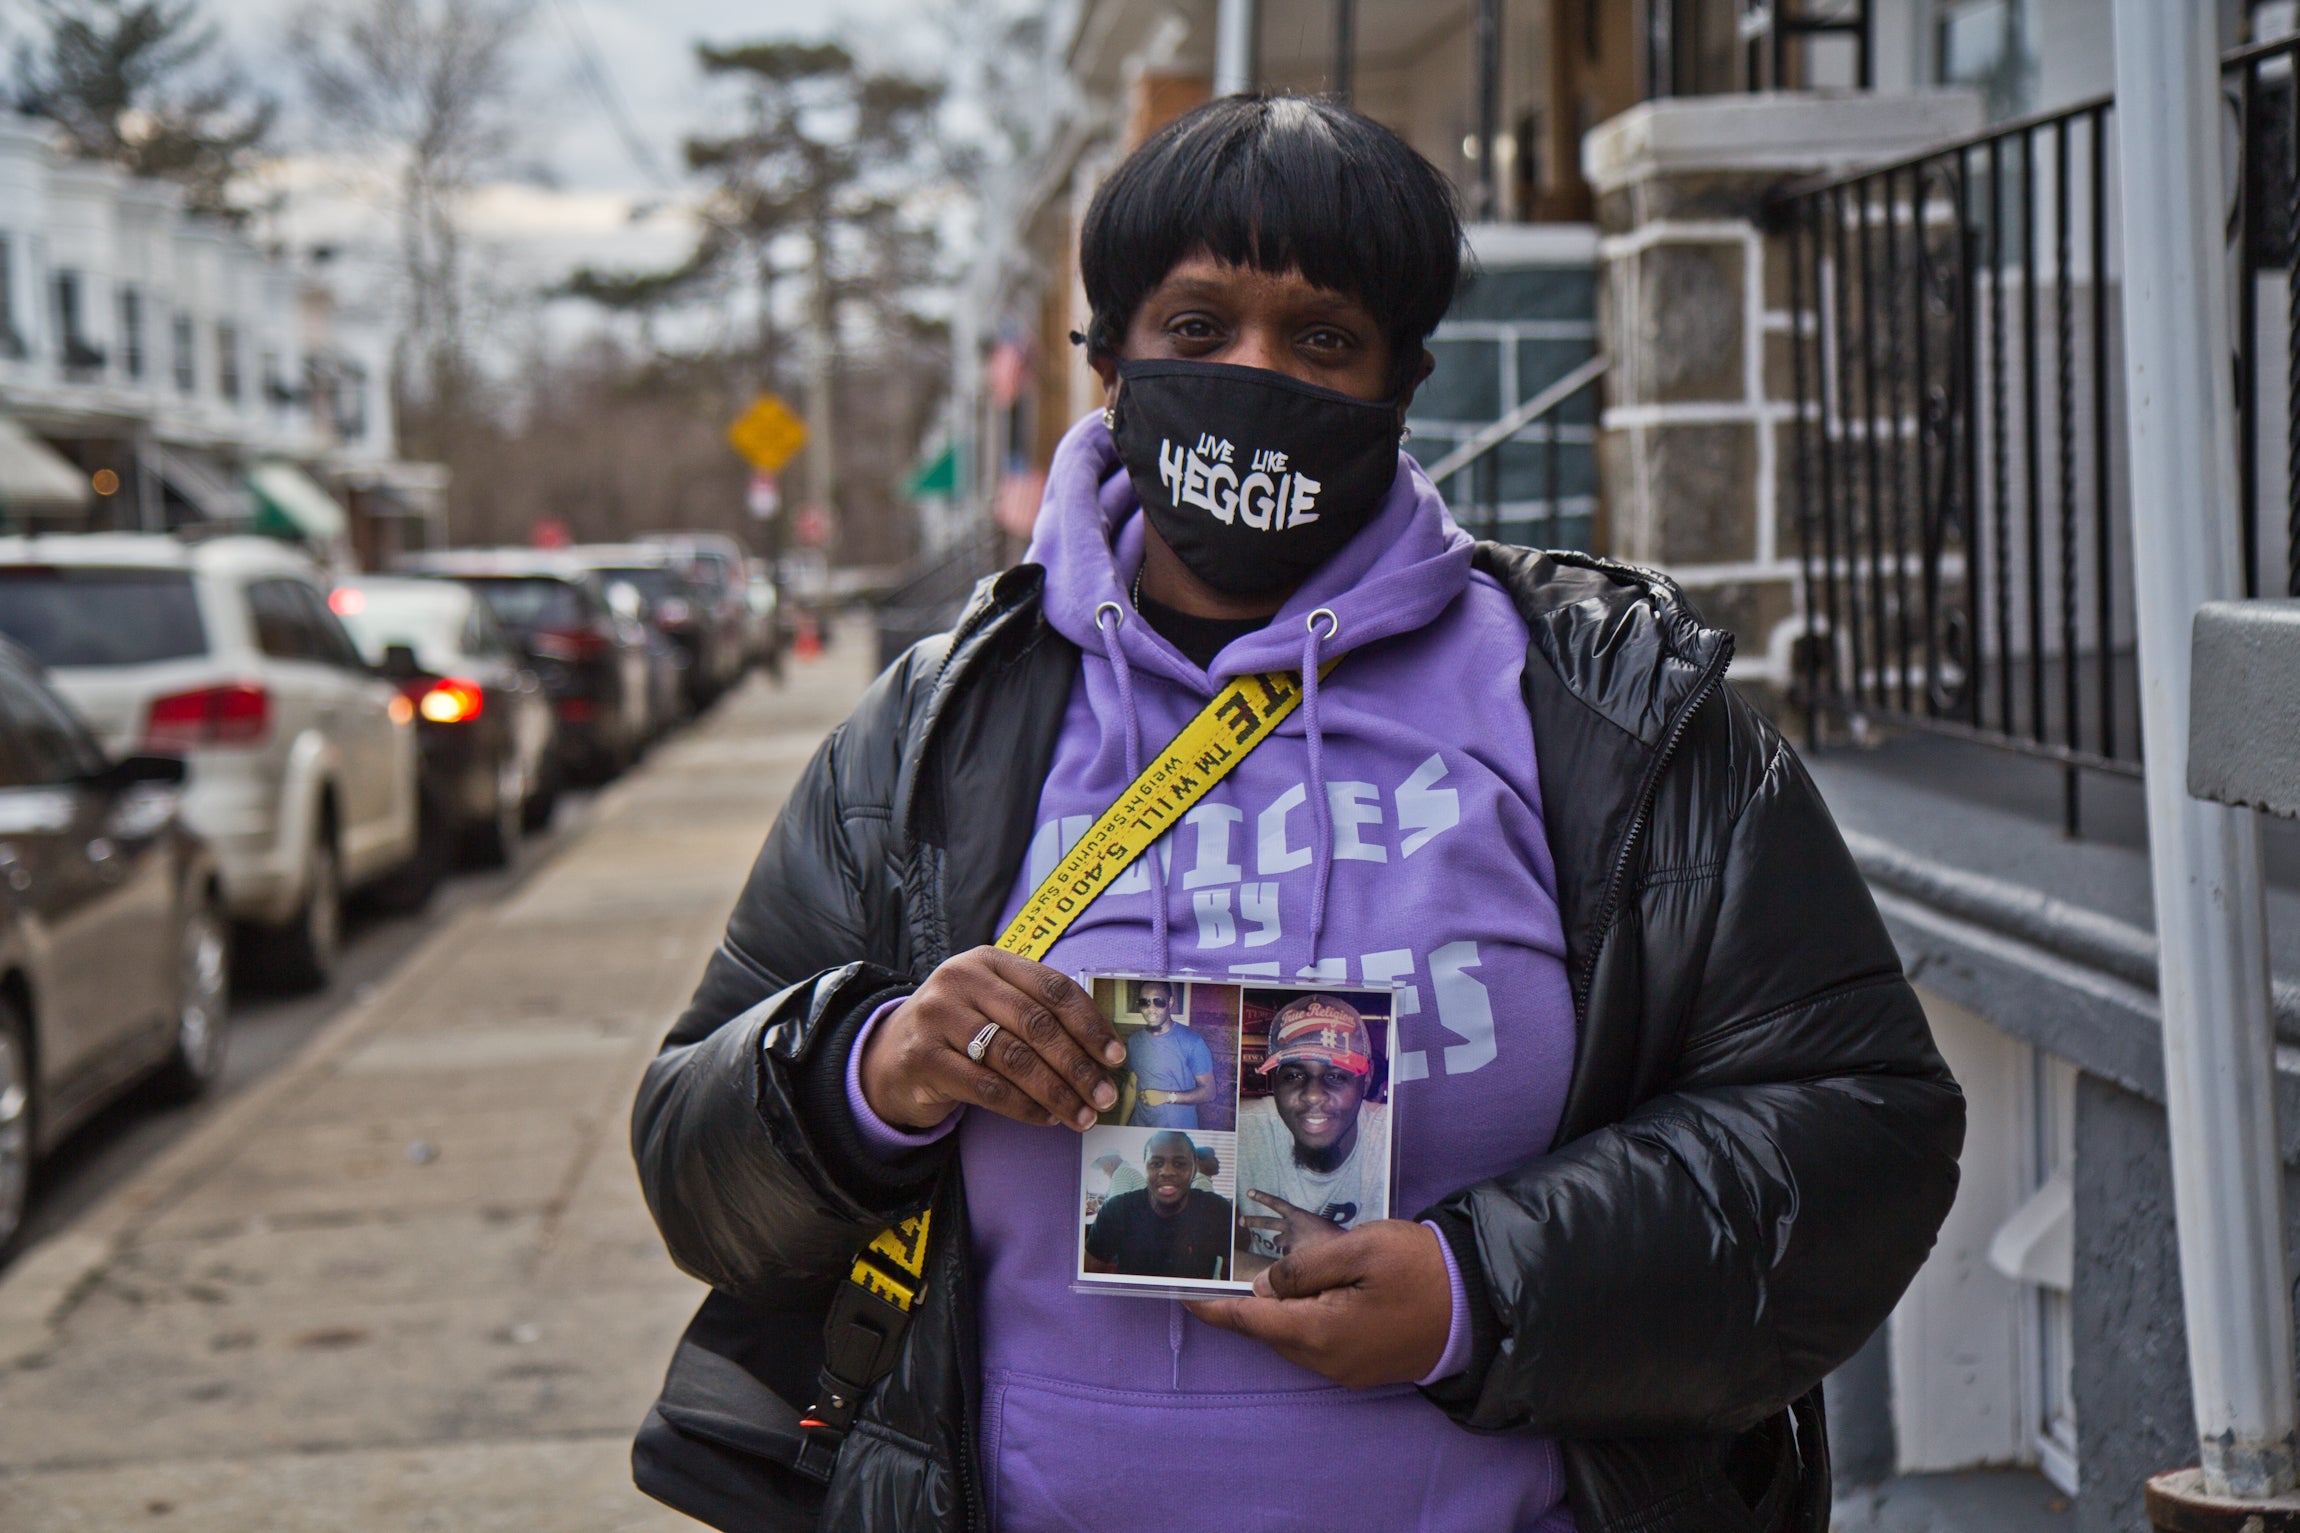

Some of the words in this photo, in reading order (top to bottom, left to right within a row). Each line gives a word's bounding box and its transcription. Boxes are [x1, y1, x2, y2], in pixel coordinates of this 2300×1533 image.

[1197, 432, 1235, 463] LIVE
[1251, 449, 1289, 473] LIKE
[1159, 438, 1321, 532] HEGGIE
[1194, 743, 1233, 775] TM
[1131, 775, 1200, 830] WILL
[1003, 885, 1060, 949] System
[1193, 882, 1281, 950] BY
[1281, 1009, 1305, 1028] True
[1305, 1003, 1356, 1028] Religion
